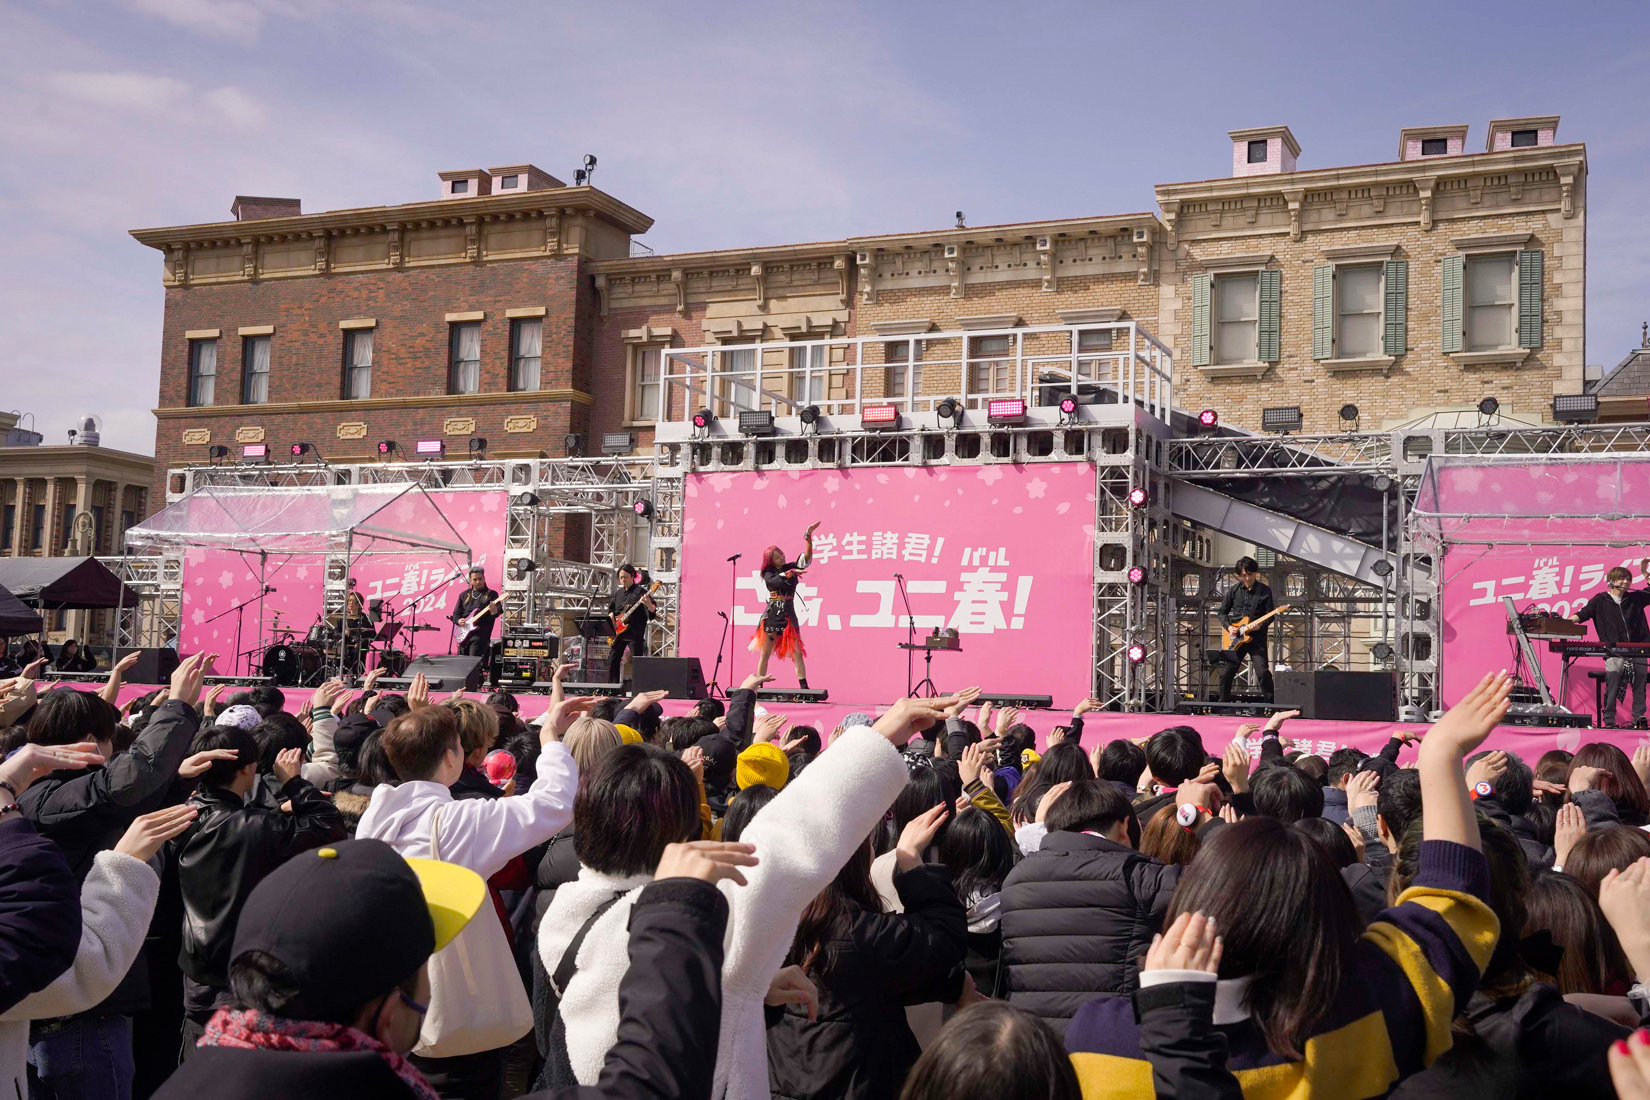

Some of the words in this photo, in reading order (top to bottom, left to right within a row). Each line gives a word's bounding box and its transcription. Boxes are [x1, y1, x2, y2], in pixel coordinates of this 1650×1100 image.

[811, 531, 945, 565] 学生諸君!
[960, 547, 1010, 566] バル
[401, 590, 447, 617] 2024
